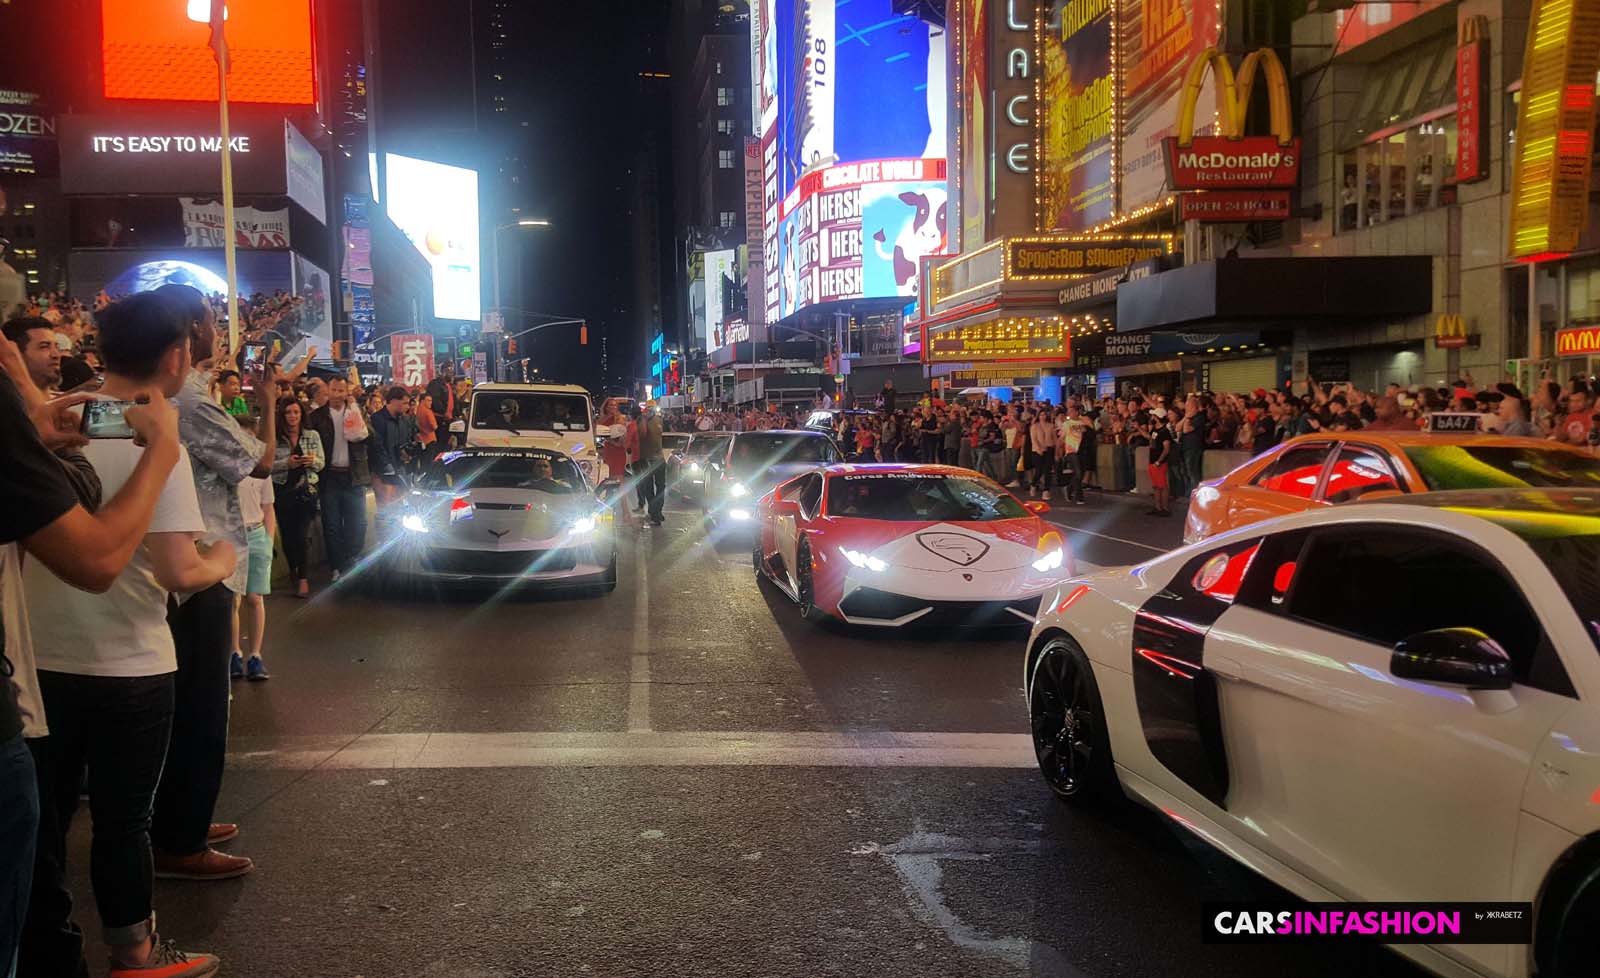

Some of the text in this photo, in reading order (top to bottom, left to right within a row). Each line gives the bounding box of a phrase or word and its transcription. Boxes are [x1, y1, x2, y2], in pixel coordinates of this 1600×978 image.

[814, 38, 826, 88] 108
[94, 137, 124, 152] IT'S
[128, 137, 171, 152] EASY
[173, 137, 196, 152] TO
[1178, 152, 1294, 169] McDonald's
[1186, 200, 1221, 212] OPEN
[1059, 282, 1091, 304] CHANGE
[1105, 335, 1152, 355] CHANGE MONEY
[403, 340, 427, 387] tkts
